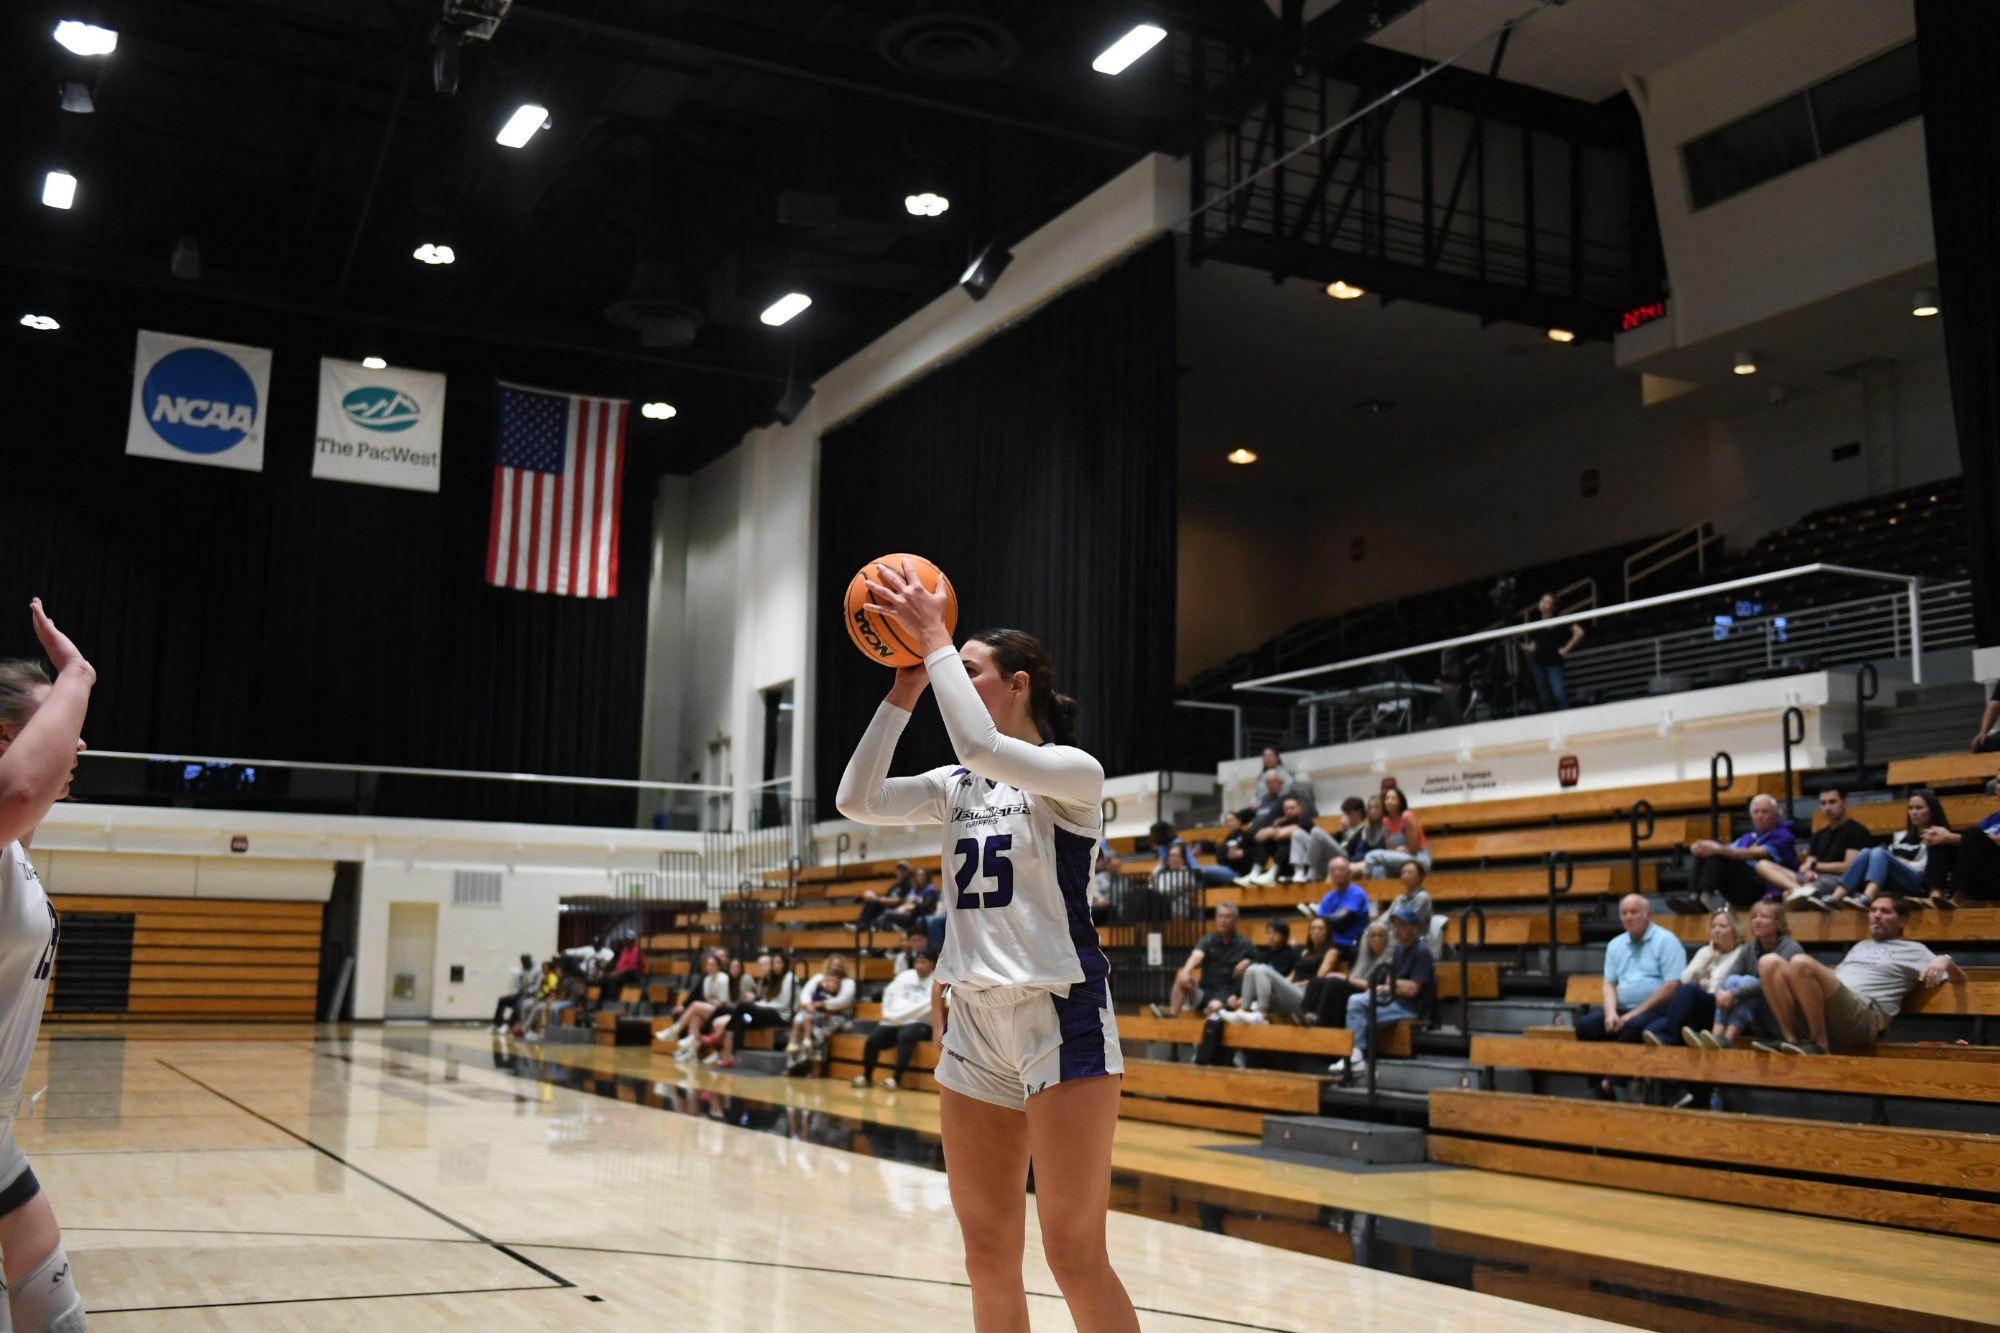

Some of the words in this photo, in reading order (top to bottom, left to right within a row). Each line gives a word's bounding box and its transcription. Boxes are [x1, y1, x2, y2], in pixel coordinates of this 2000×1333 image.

[151, 394, 252, 435] NCAA
[317, 436, 354, 457] The
[357, 440, 440, 468] PacWest
[854, 608, 895, 658] NCAA
[954, 833, 1014, 910] 25
